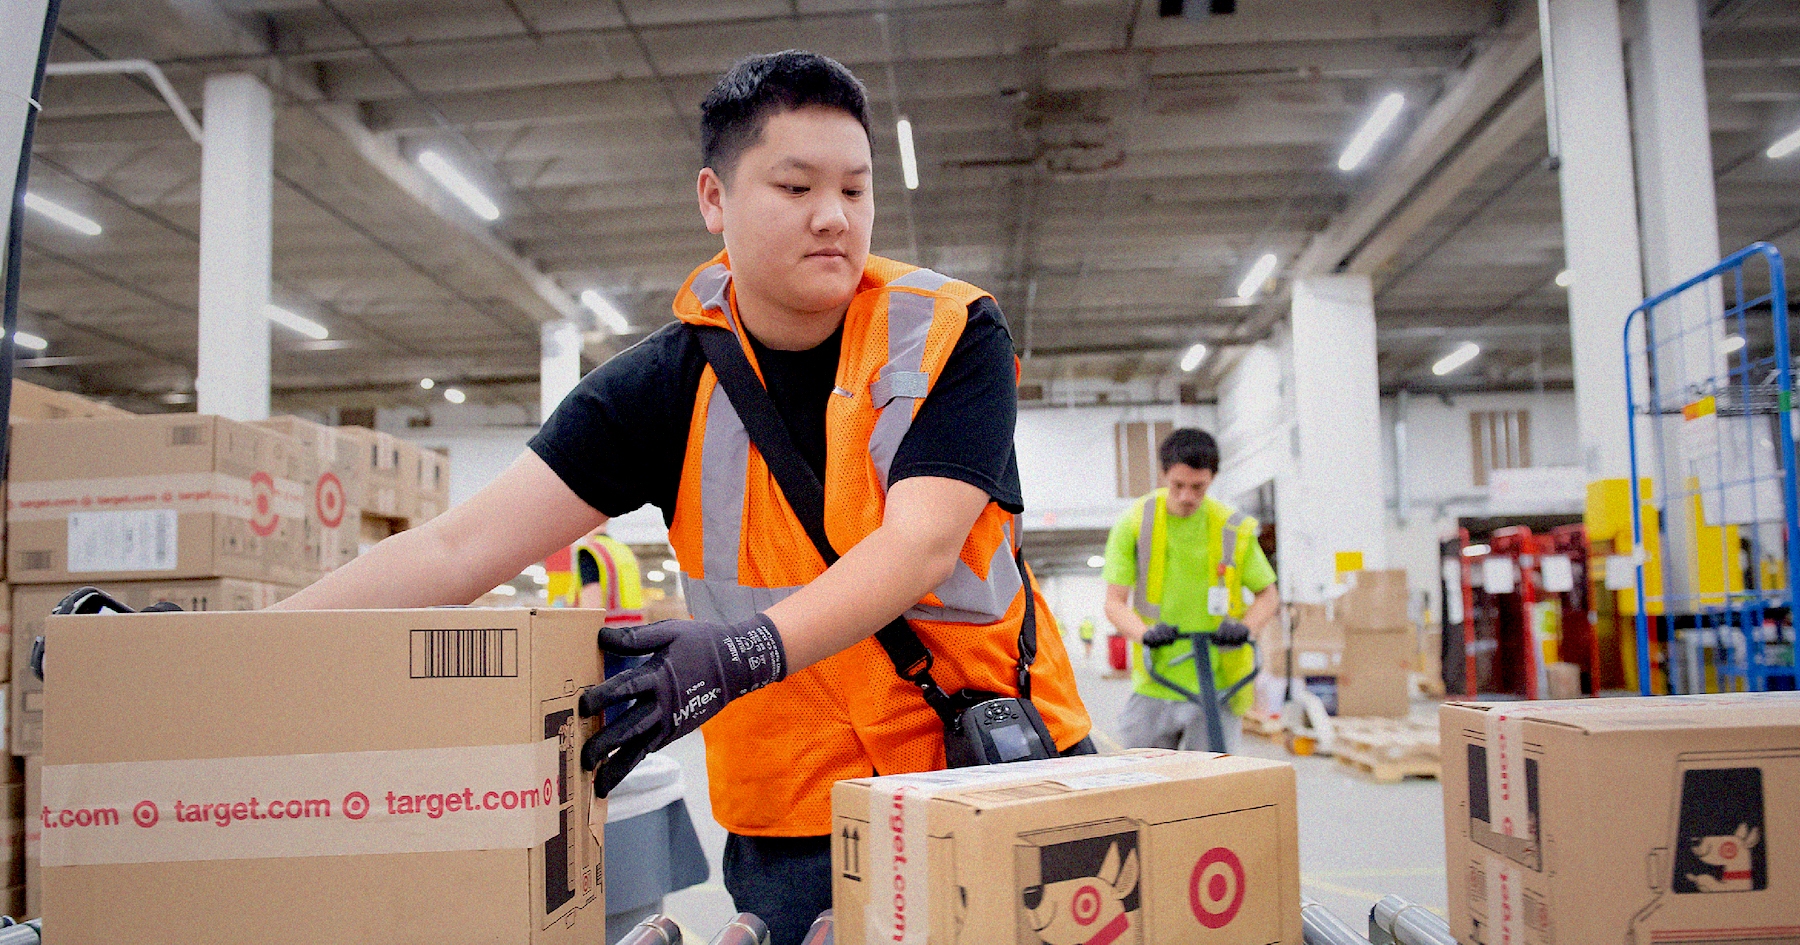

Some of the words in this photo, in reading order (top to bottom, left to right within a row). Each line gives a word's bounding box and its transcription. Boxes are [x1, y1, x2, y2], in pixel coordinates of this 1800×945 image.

[40, 805, 119, 828] t.com
[174, 797, 332, 828] target.com
[384, 787, 540, 820] target.com
